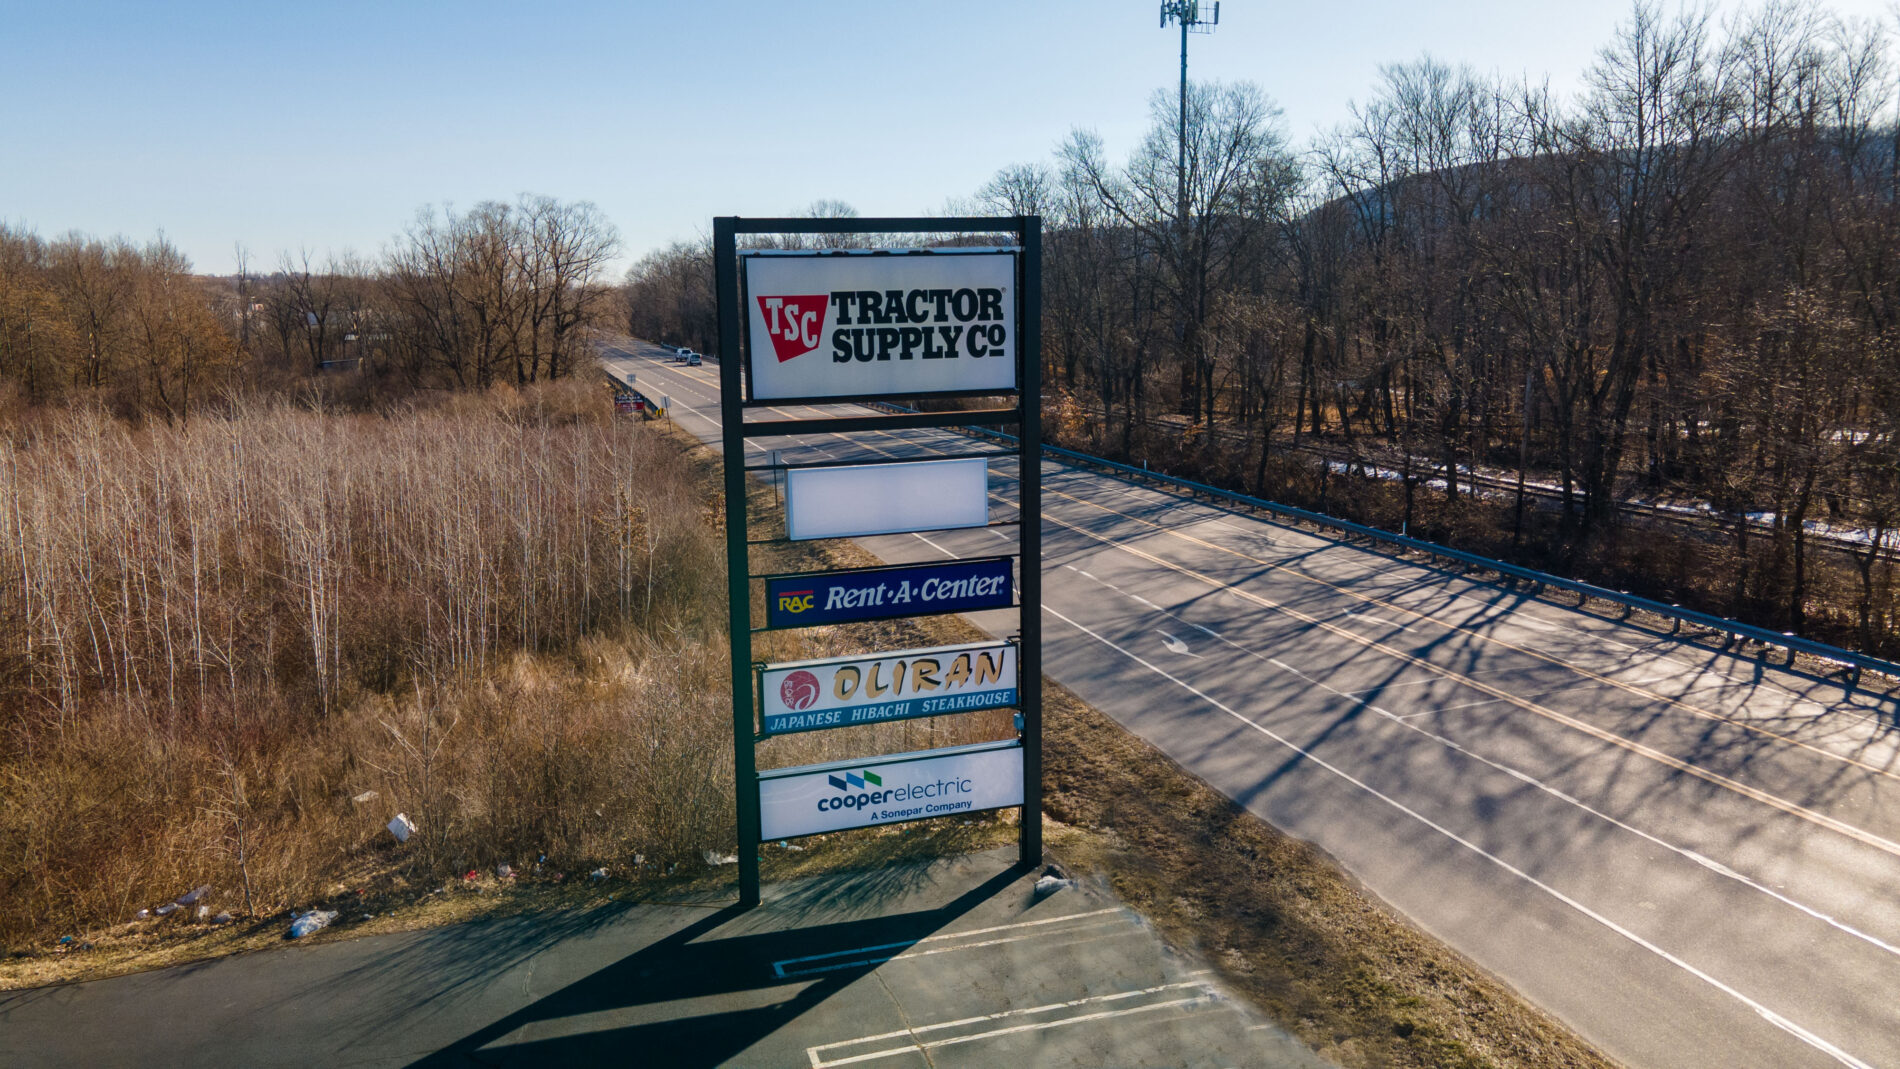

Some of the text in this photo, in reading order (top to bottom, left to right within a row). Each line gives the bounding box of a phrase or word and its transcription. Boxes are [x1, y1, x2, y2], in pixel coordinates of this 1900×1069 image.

[765, 298, 817, 348] TSC
[830, 287, 1004, 325] TRACTOR
[832, 325, 963, 363] SUPPLY
[779, 595, 814, 613] RAC
[770, 691, 1011, 731] JAPANESE HIBACHI STEAKHOUSE
[870, 800, 973, 820] A Sonepar Company
